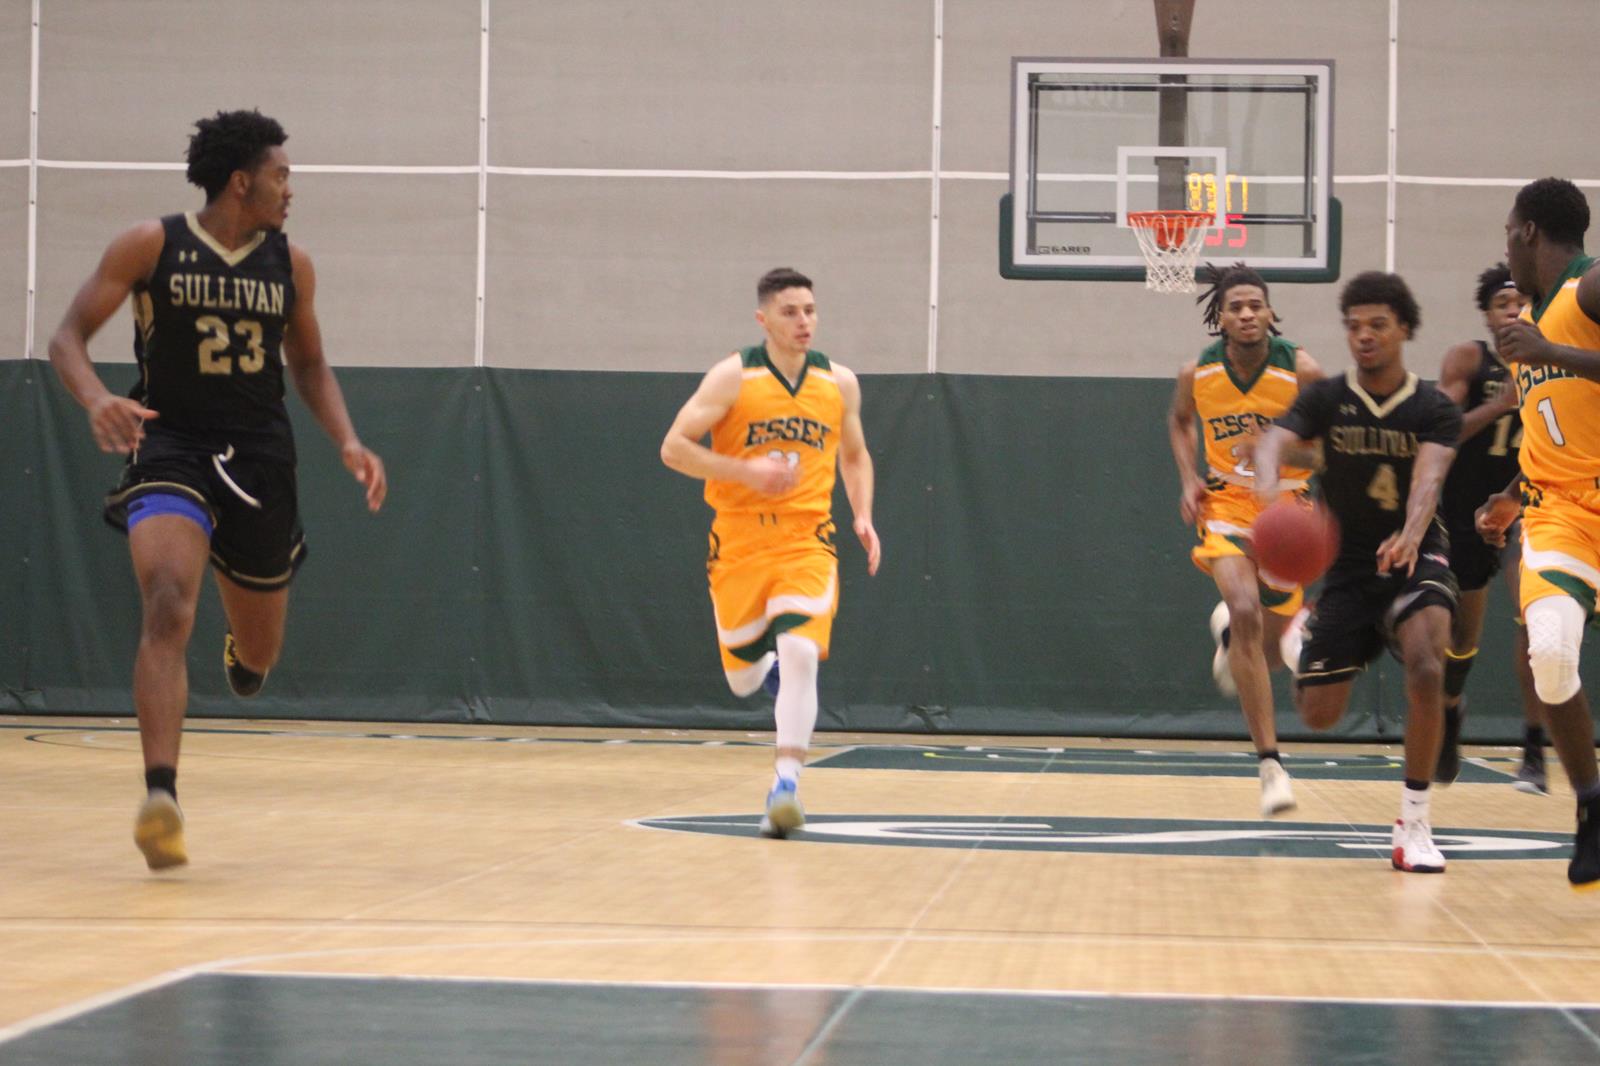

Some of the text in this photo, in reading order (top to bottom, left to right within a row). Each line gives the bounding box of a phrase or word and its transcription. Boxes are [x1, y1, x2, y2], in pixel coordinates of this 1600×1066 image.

[169, 273, 284, 315] SULLIVAN
[195, 315, 265, 374] 23
[1537, 397, 1566, 446] 1
[1366, 463, 1399, 510] 4
